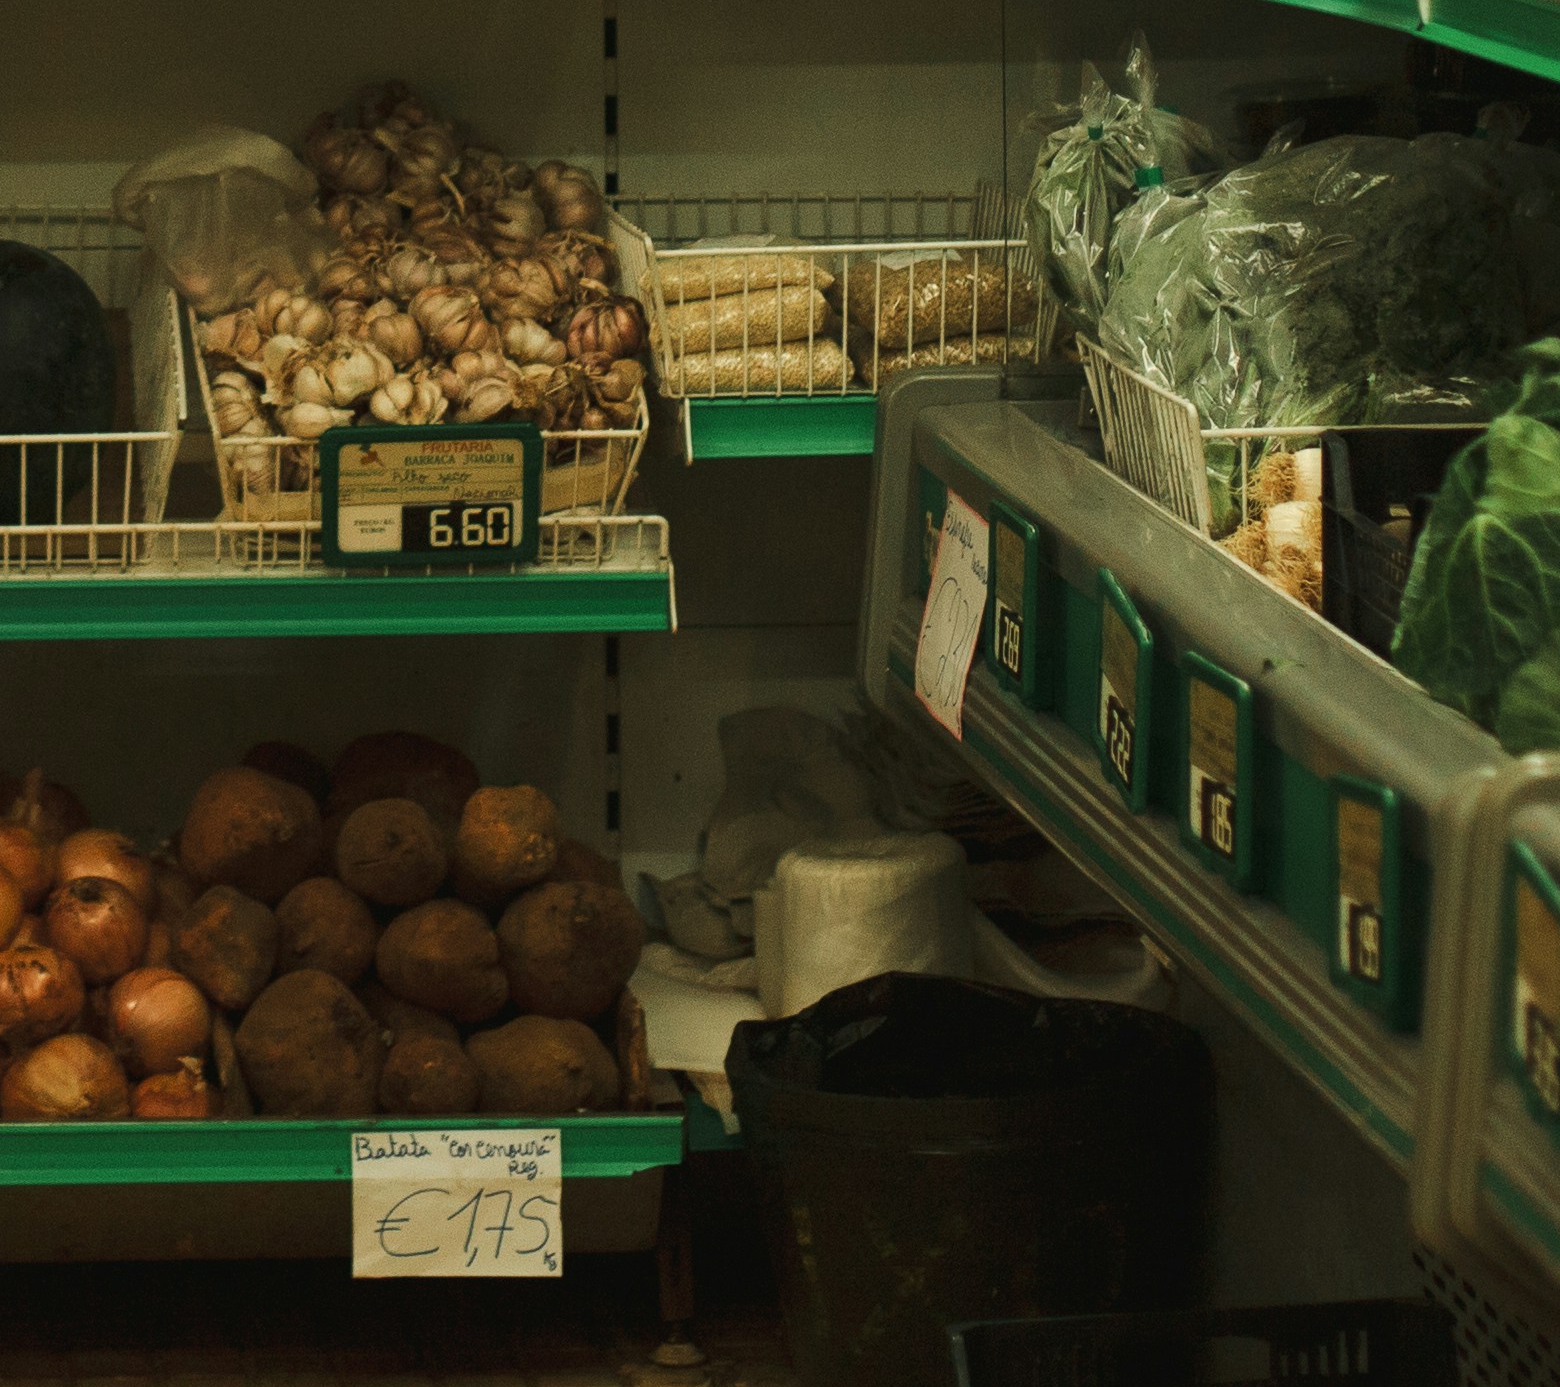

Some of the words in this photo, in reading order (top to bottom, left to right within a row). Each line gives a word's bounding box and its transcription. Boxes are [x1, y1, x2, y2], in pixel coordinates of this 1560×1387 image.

[421, 442, 493, 453] FRUTARIA
[404, 455, 455, 465] BARRACA
[430, 507, 510, 547] 6.60
[355, 1134, 431, 1161] Batata
